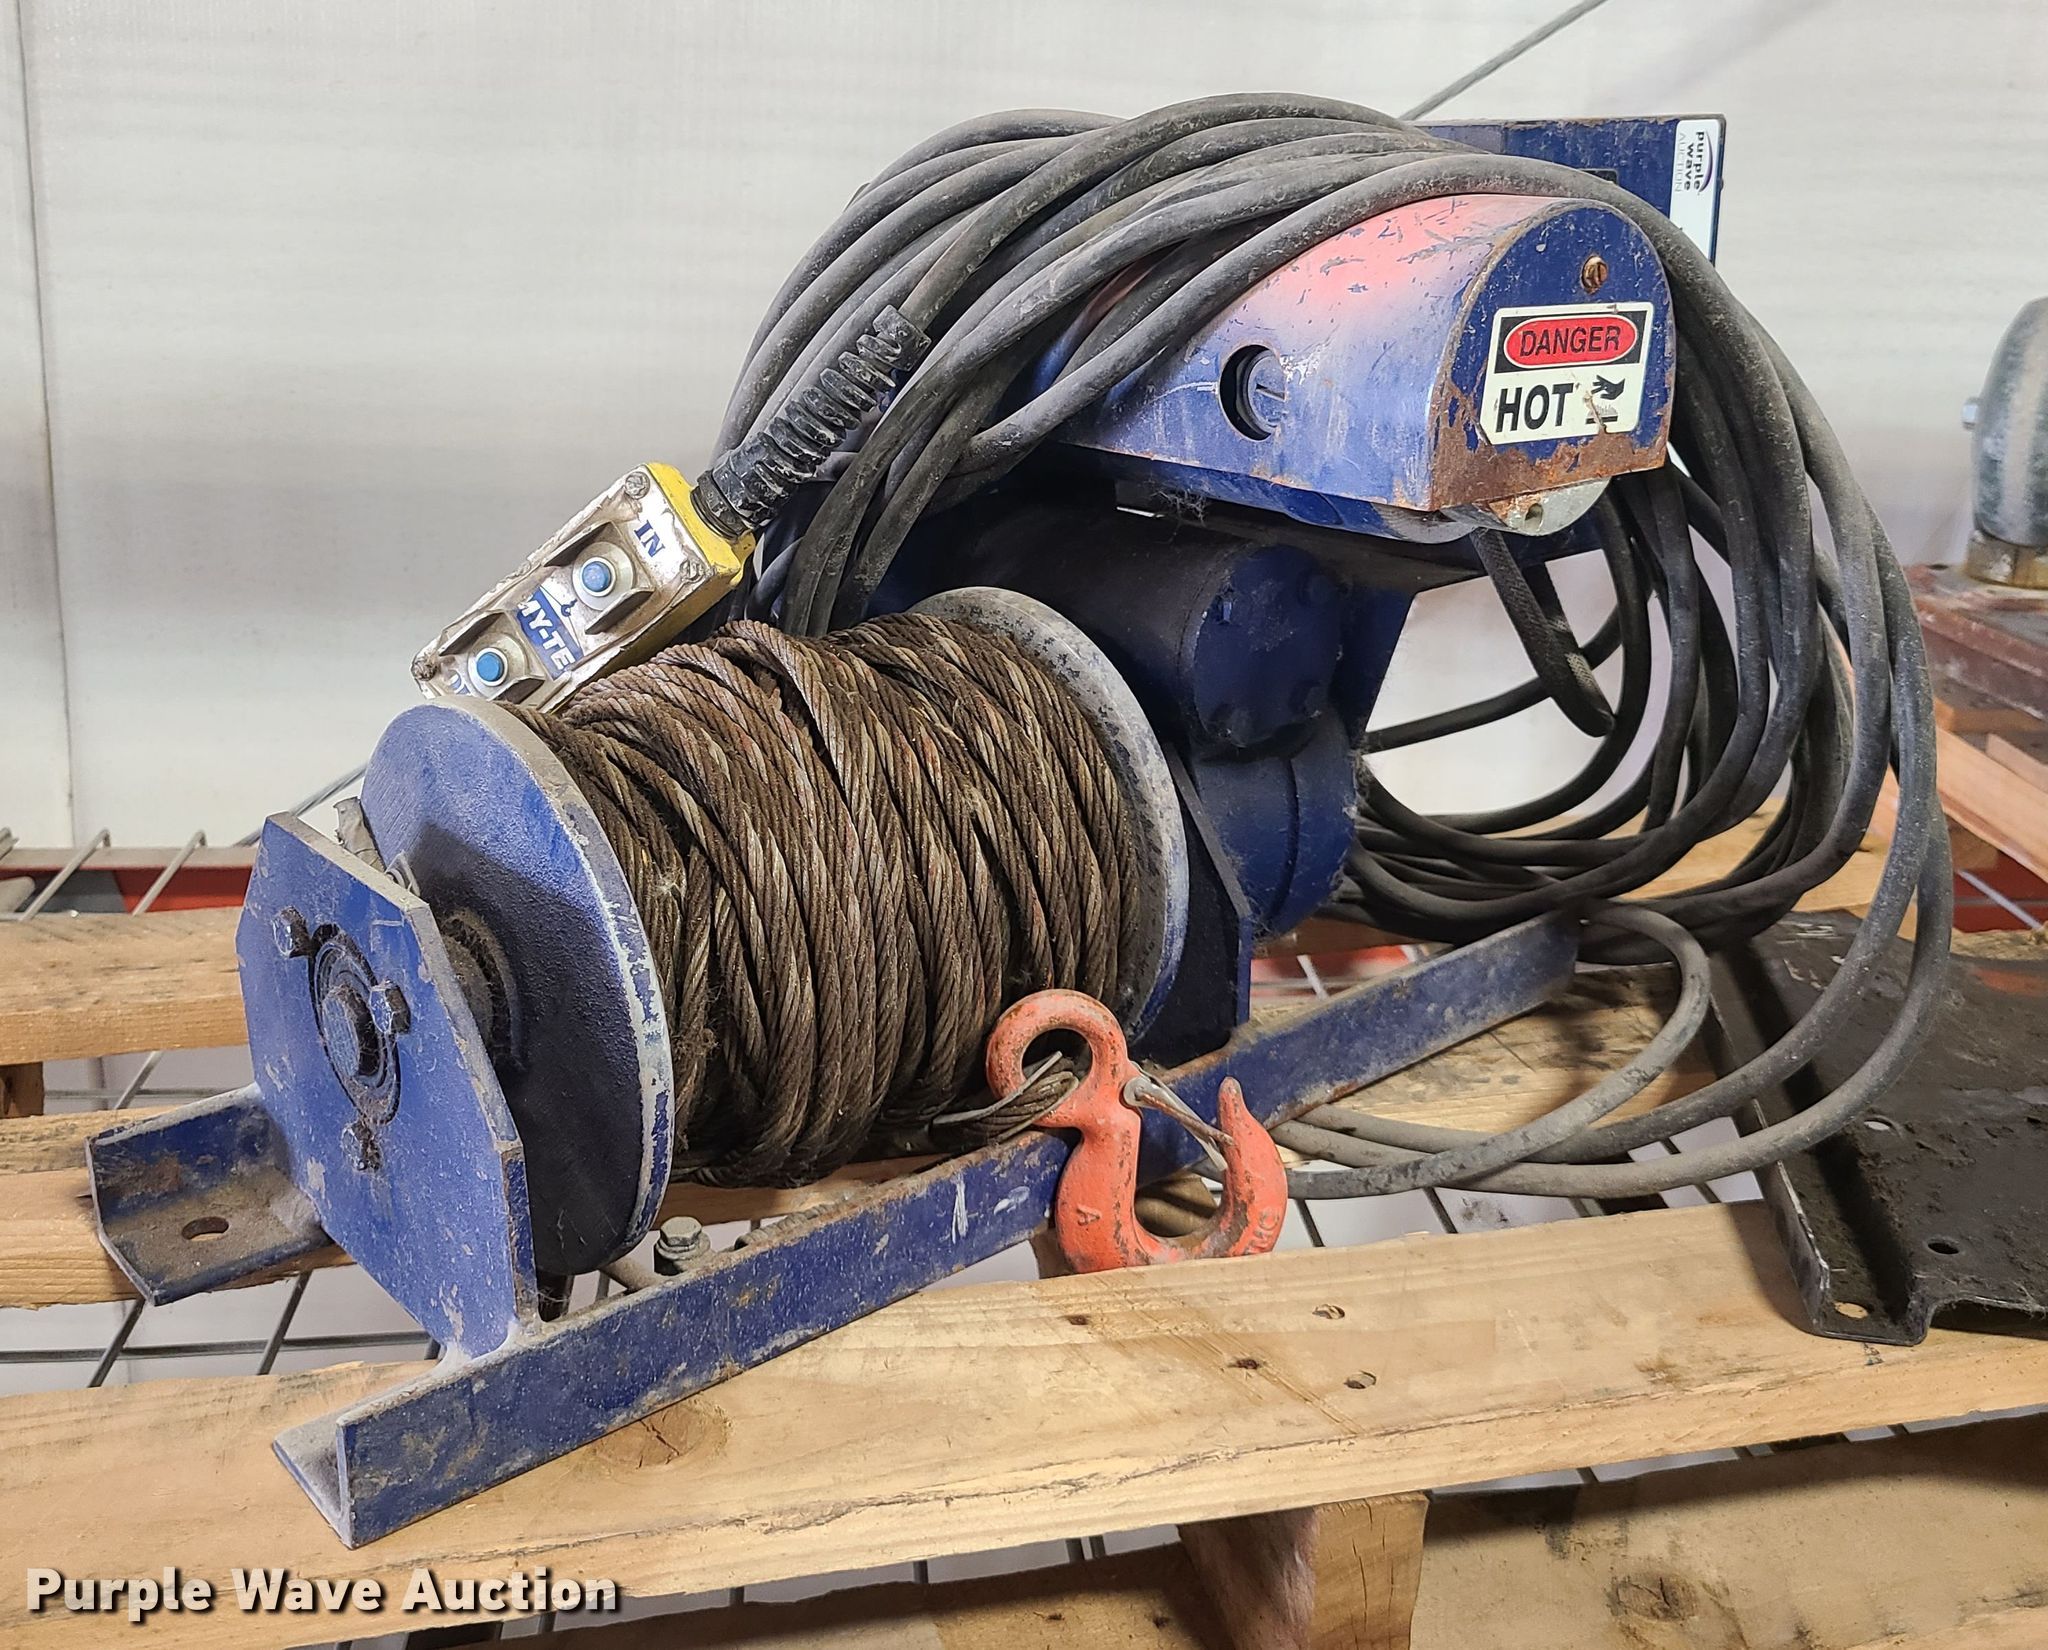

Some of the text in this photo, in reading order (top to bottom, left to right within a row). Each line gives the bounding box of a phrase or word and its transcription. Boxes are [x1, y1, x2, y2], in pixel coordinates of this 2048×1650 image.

[1683, 143, 1695, 191] wave
[1693, 131, 1705, 190] purple
[1520, 326, 1621, 357] DANGER
[1497, 383, 1574, 433] HOT
[634, 519, 666, 558] IN
[517, 596, 576, 670] MY-TE
